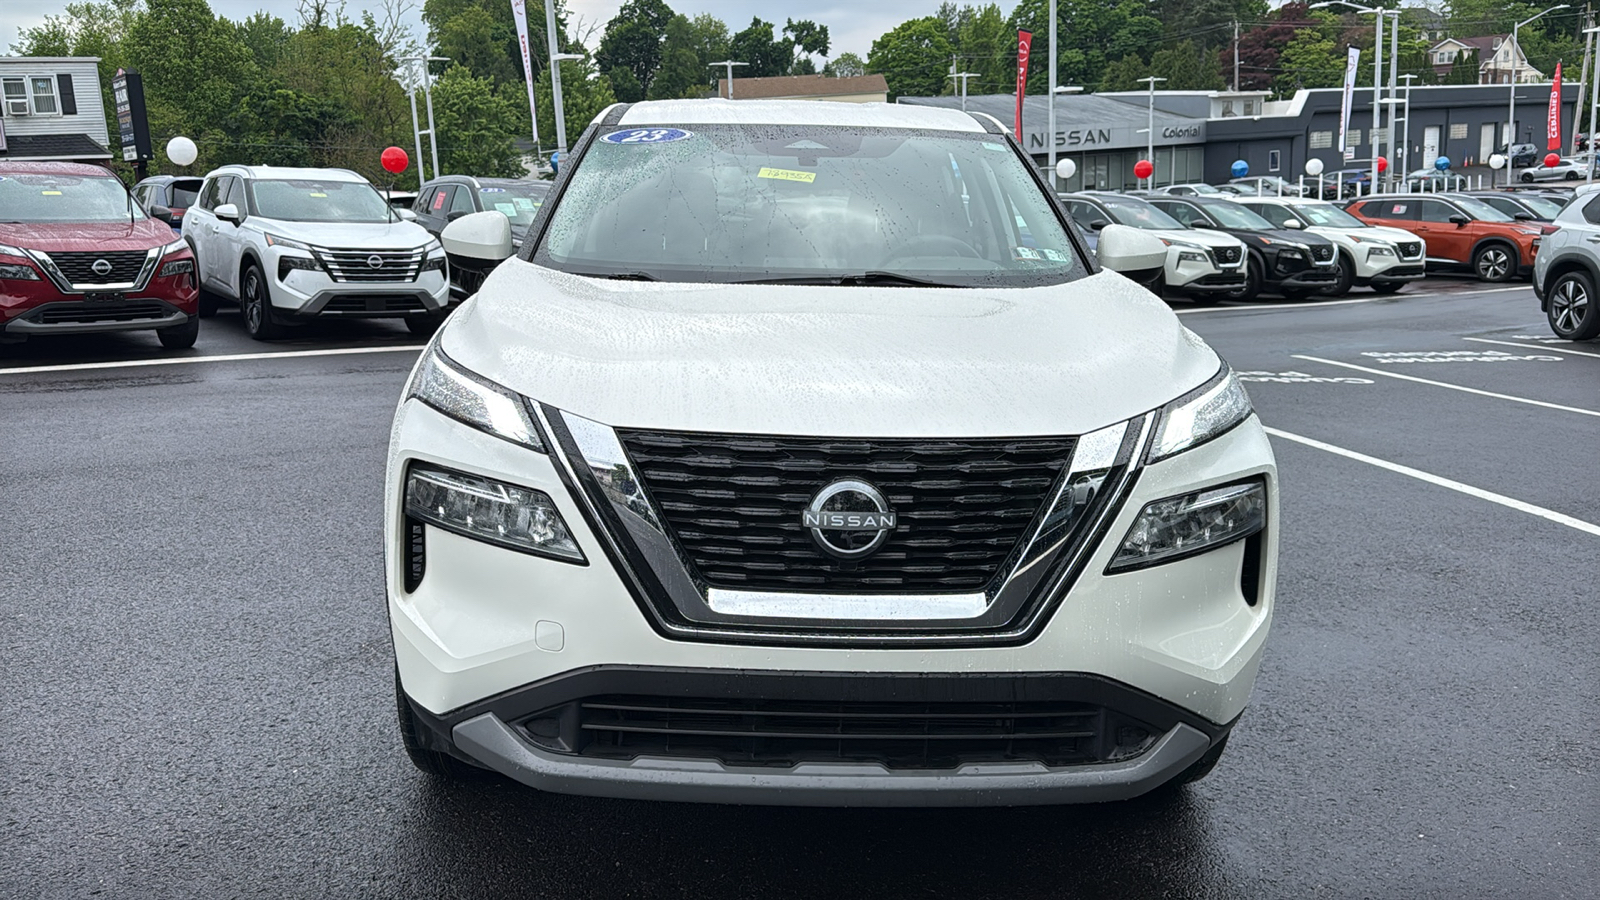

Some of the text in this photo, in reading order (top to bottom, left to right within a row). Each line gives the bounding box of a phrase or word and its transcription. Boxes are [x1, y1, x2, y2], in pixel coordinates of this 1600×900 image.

[621, 130, 669, 142] 23
[1031, 129, 1111, 148] NISSAN
[1162, 126, 1200, 139] Colonial
[806, 514, 893, 527] NISSAN
